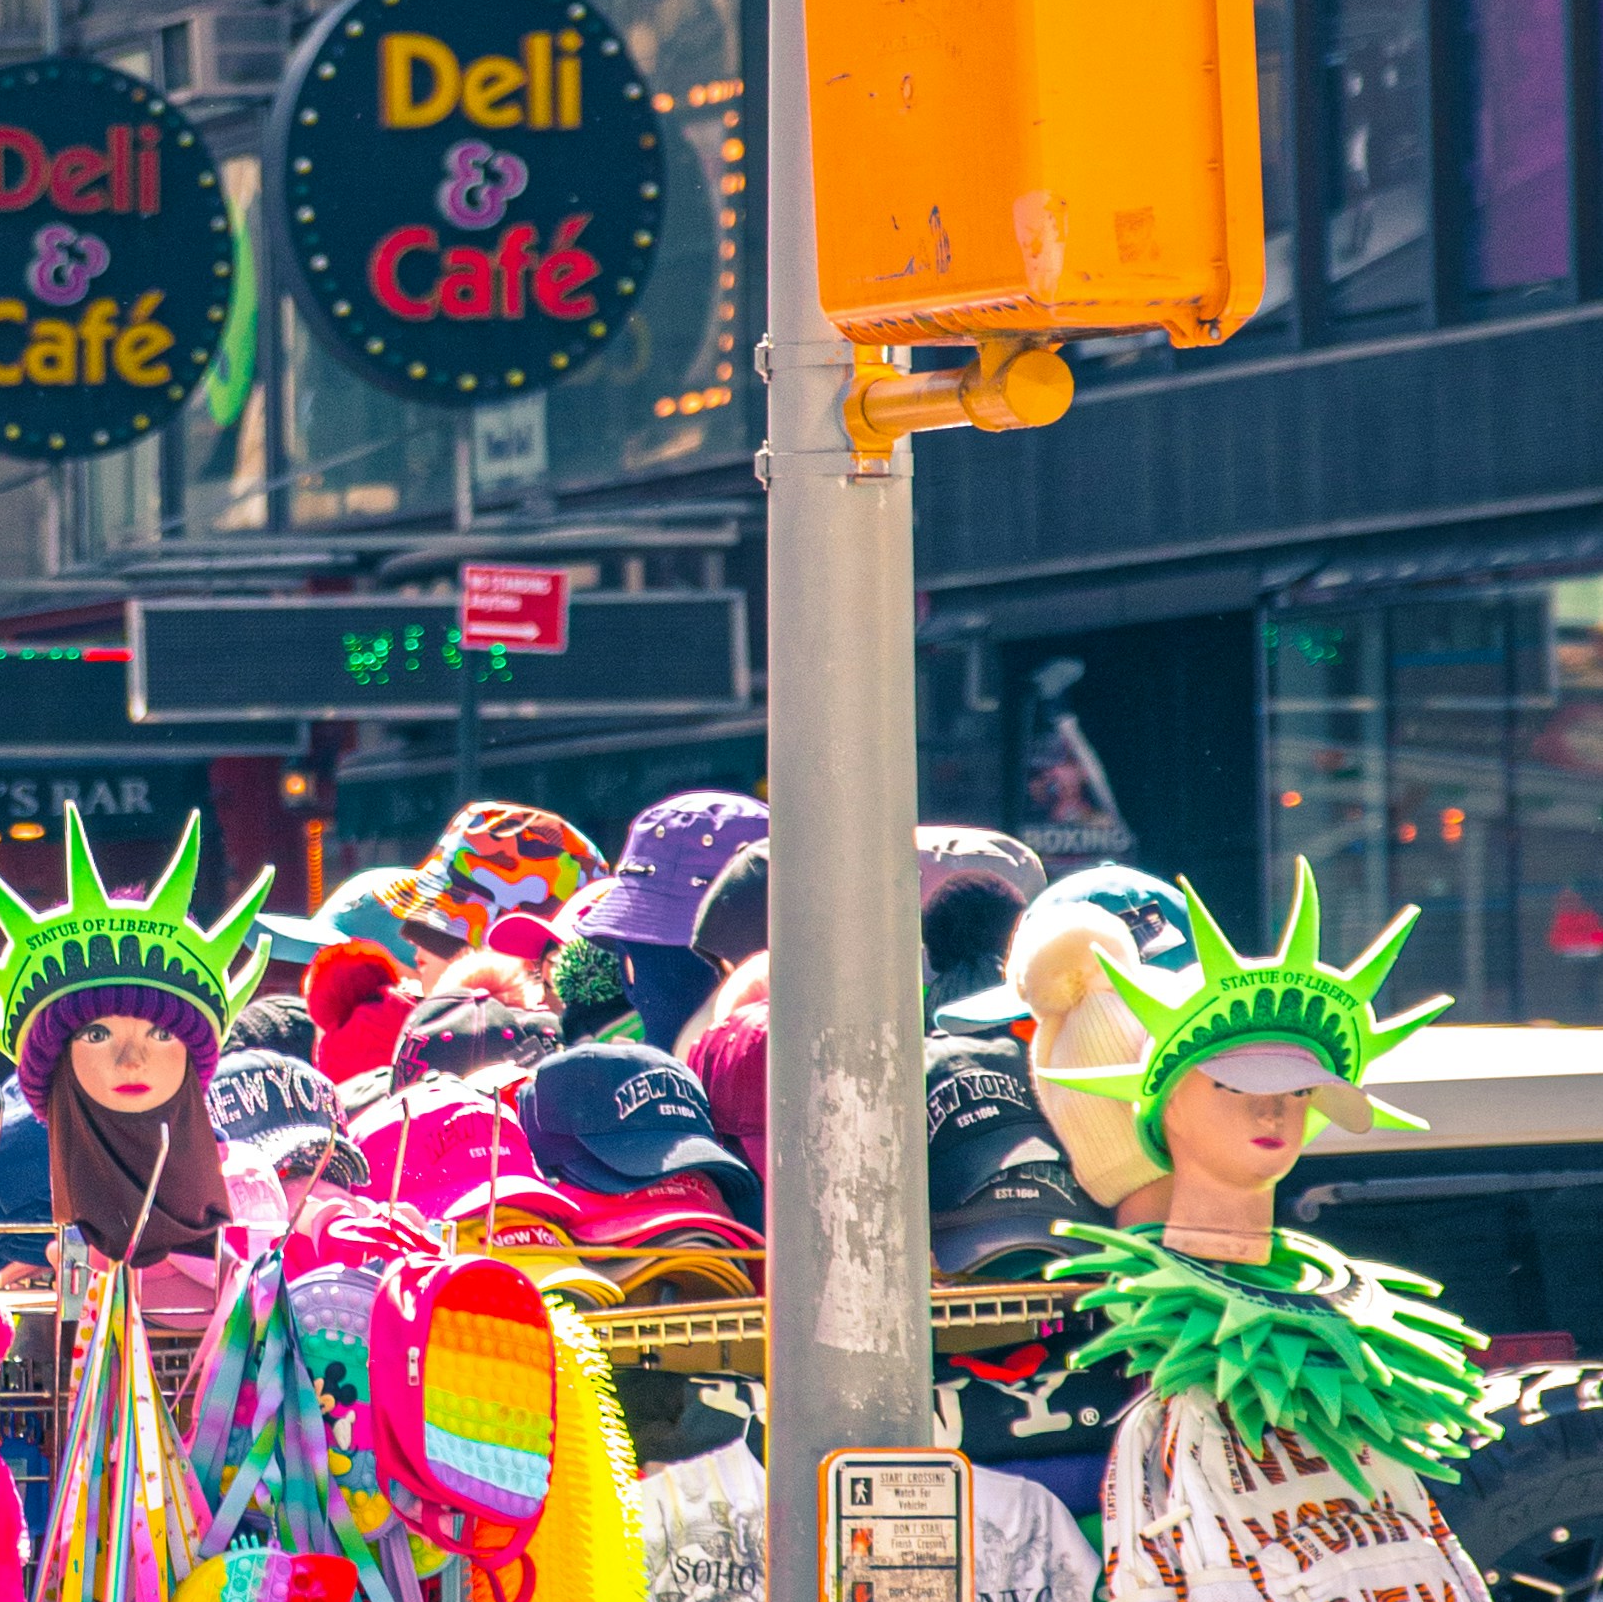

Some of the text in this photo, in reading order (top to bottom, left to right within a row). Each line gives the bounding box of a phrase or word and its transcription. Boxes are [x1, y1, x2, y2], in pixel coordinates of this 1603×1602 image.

[377, 26, 585, 131] Deli
[435, 136, 530, 230] &
[25, 222, 111, 307] &
[368, 212, 600, 321] Café
[50, 777, 153, 816] BAR
[25, 918, 179, 951] STATUE OF LIBERTY
[1219, 970, 1360, 1012] STATUE OF LIBERTY
[615, 1068, 667, 1120] NEW
[879, 1472, 947, 1485] START CROSSING
[673, 1555, 757, 1593] SOHO
